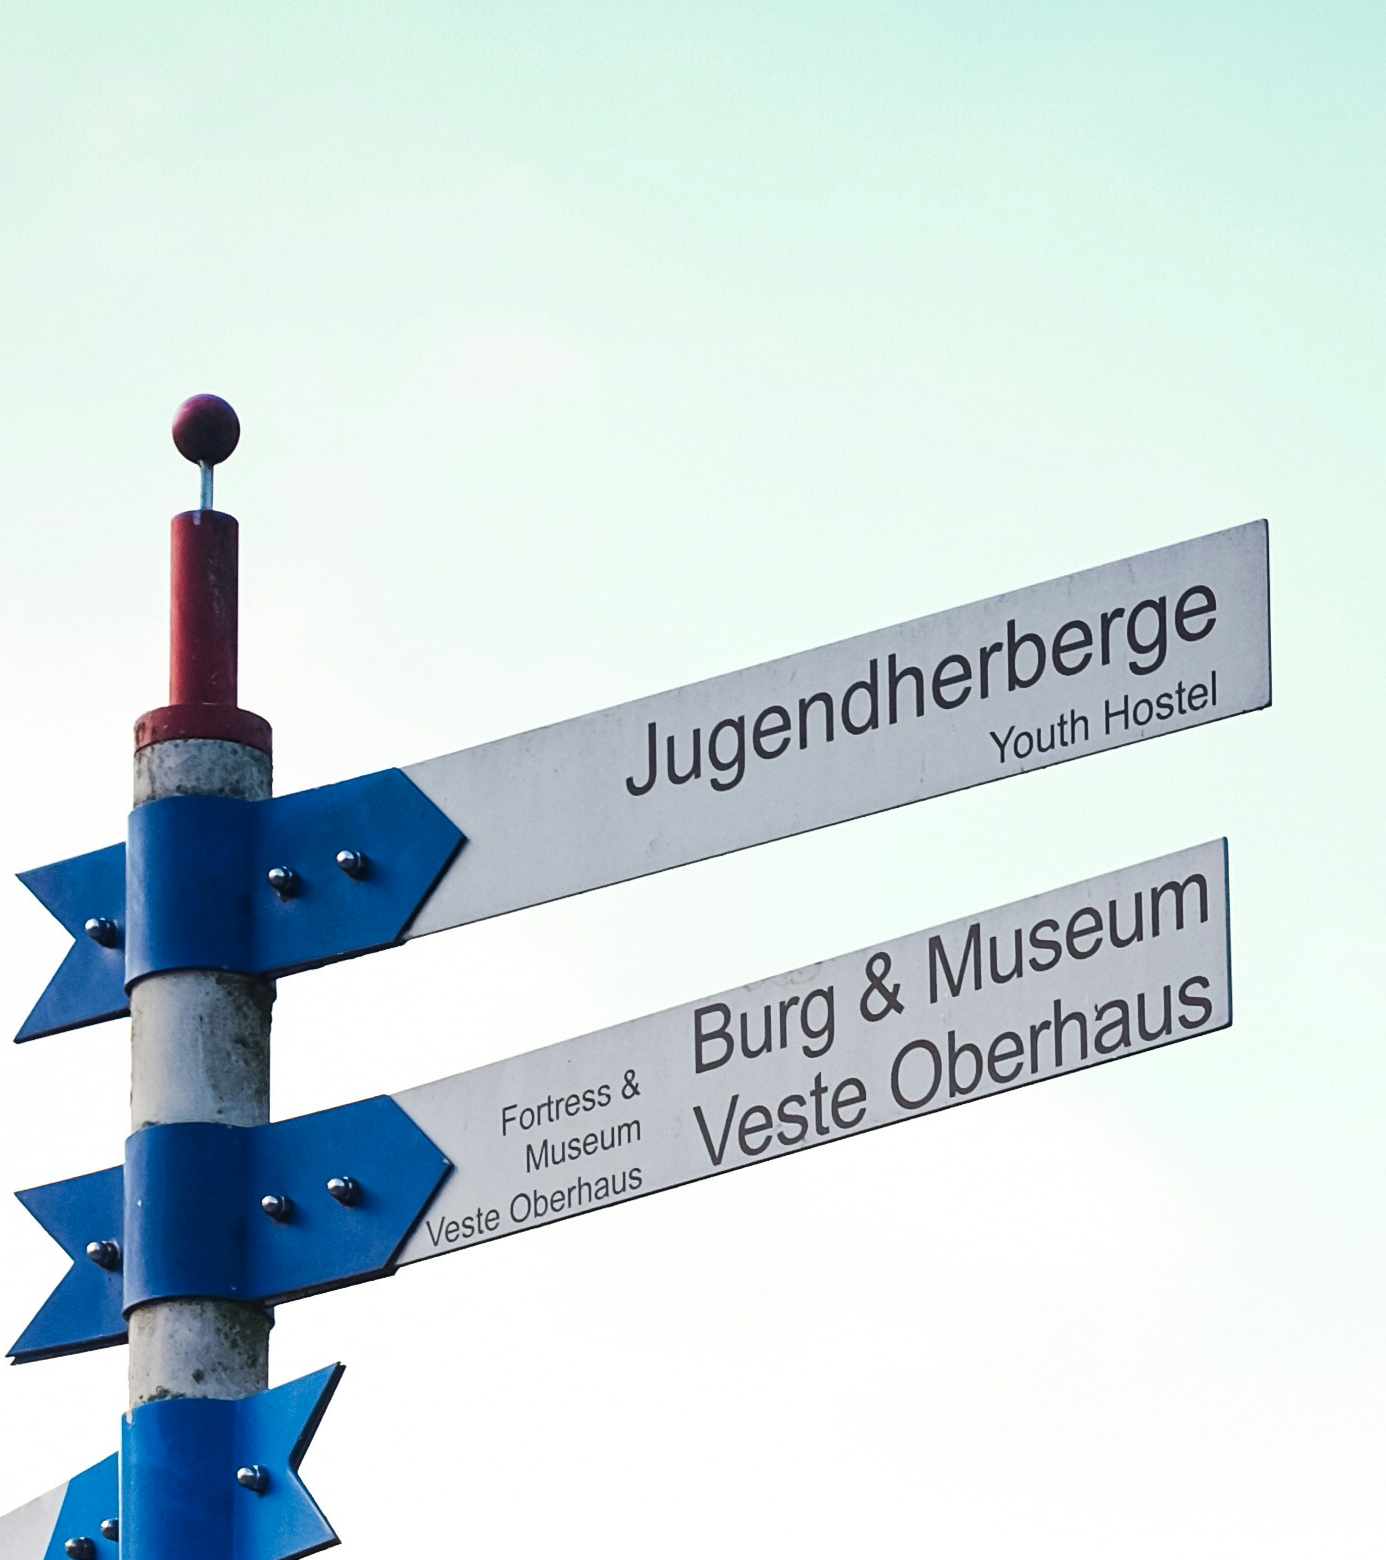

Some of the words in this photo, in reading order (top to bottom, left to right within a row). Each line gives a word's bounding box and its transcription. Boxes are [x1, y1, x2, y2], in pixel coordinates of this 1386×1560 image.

[626, 585, 1216, 796] Jugendherberge
[990, 709, 1088, 763] Youth
[1105, 671, 1216, 734] Hostel
[694, 986, 834, 1074] Burg
[860, 952, 904, 1022] &
[929, 874, 1208, 1003] Museum
[503, 1085, 611, 1136] Fortress
[622, 1069, 640, 1099] &
[693, 1072, 866, 1166] Veste
[890, 974, 1213, 1112] Oberhaus
[527, 1120, 640, 1173] Museum
[426, 1208, 499, 1246] Veste
[510, 1168, 642, 1223] Oberhaus
